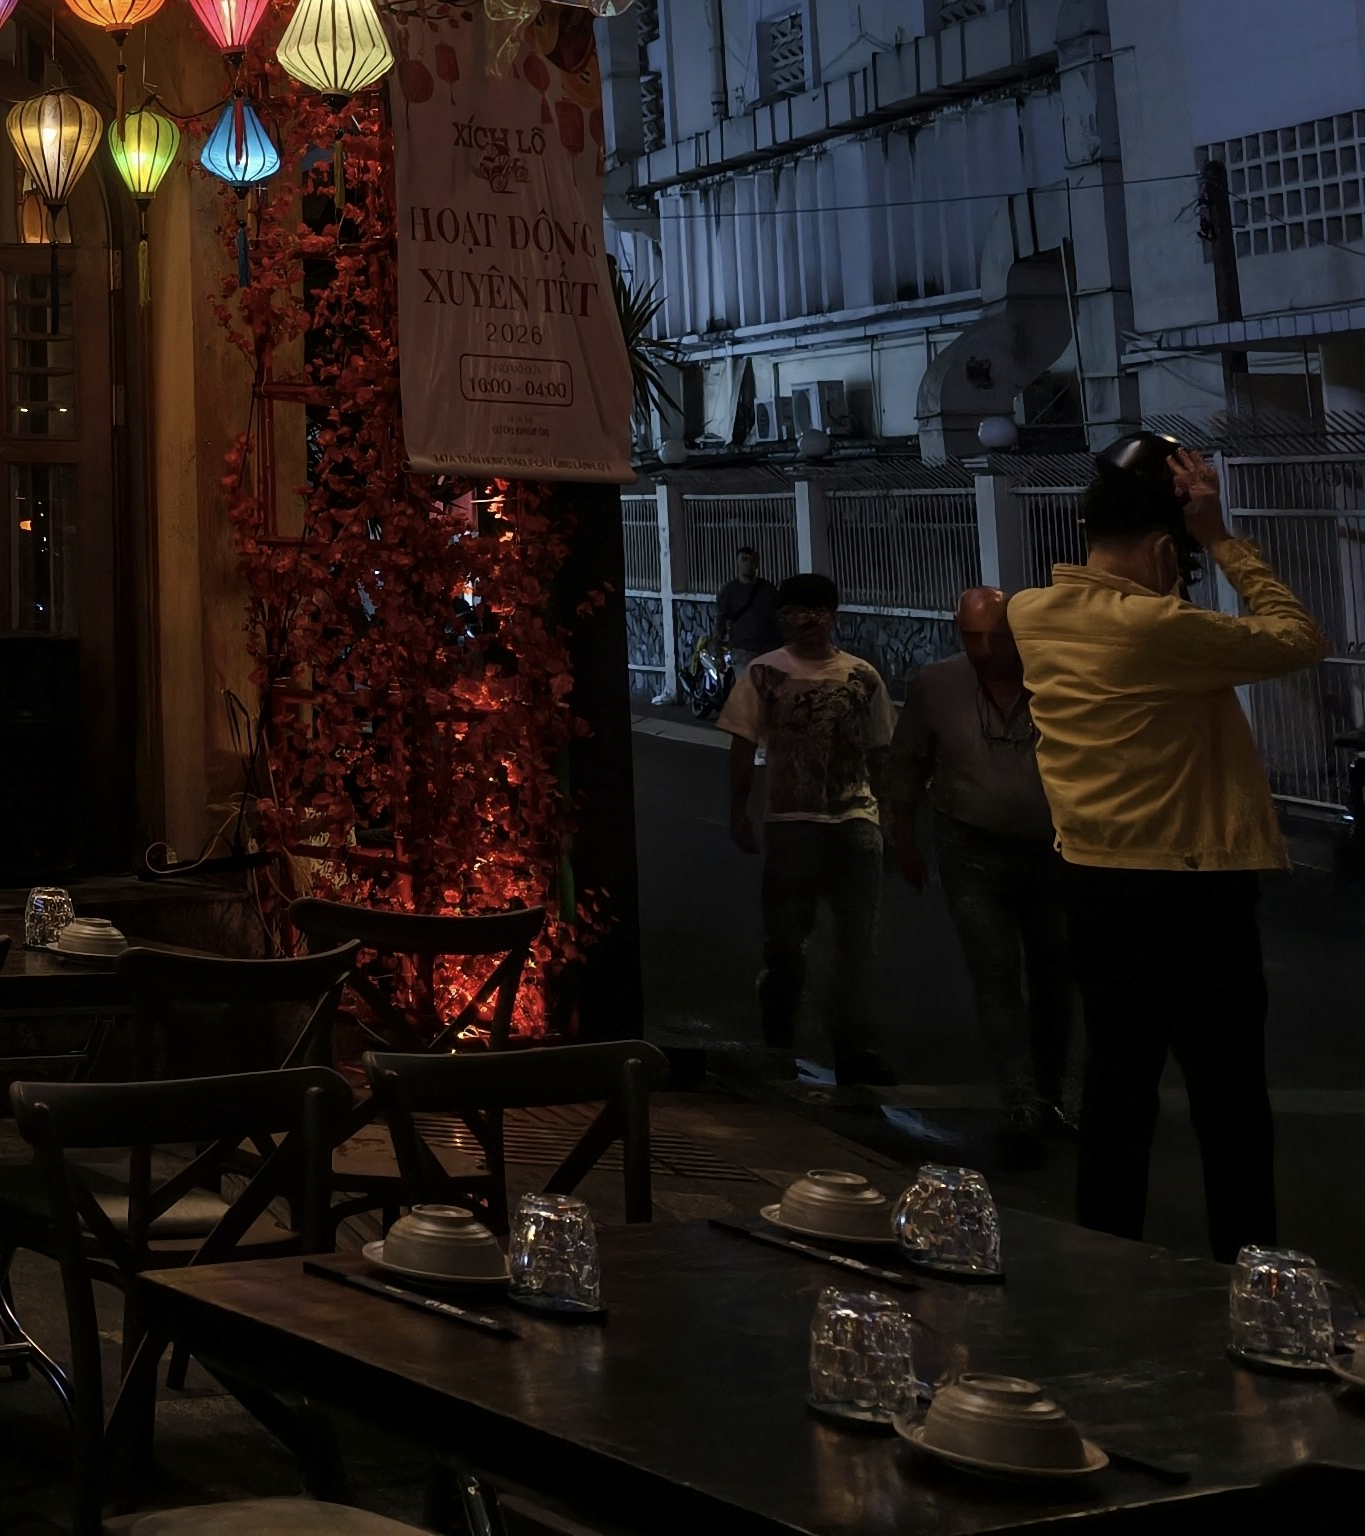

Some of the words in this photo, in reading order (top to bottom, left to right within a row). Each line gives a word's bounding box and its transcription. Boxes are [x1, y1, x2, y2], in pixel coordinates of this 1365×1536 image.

[453, 115, 509, 150] XÍCH
[516, 127, 546, 155] LÔ
[411, 207, 497, 253] HOẠT
[508, 208, 597, 261] ĐỘNG
[419, 265, 529, 311] XUYÊN
[536, 261, 598, 317] TẾT
[486, 323, 543, 345] 2026
